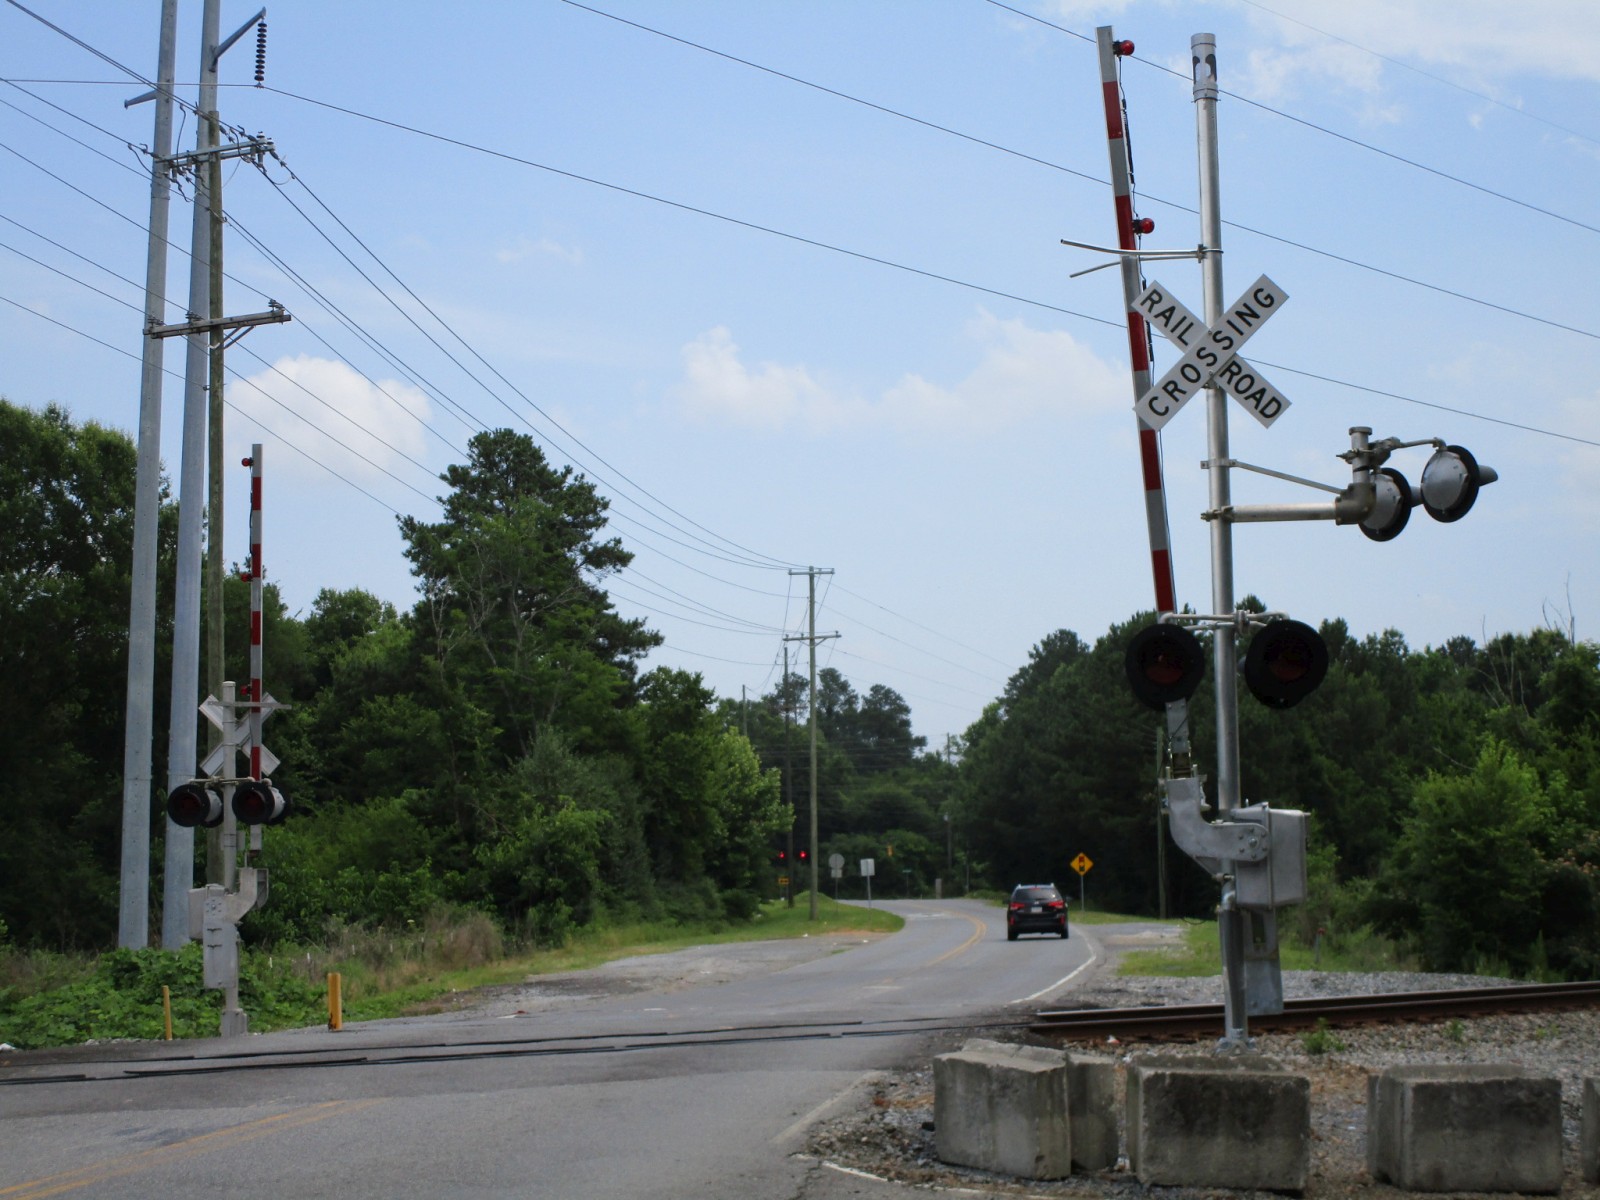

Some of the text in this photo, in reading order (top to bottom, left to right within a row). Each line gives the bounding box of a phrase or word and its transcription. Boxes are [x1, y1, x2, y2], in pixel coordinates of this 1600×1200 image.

[1140, 289, 1282, 419] RAIL ROAD
[1148, 287, 1275, 417] CROSSING
